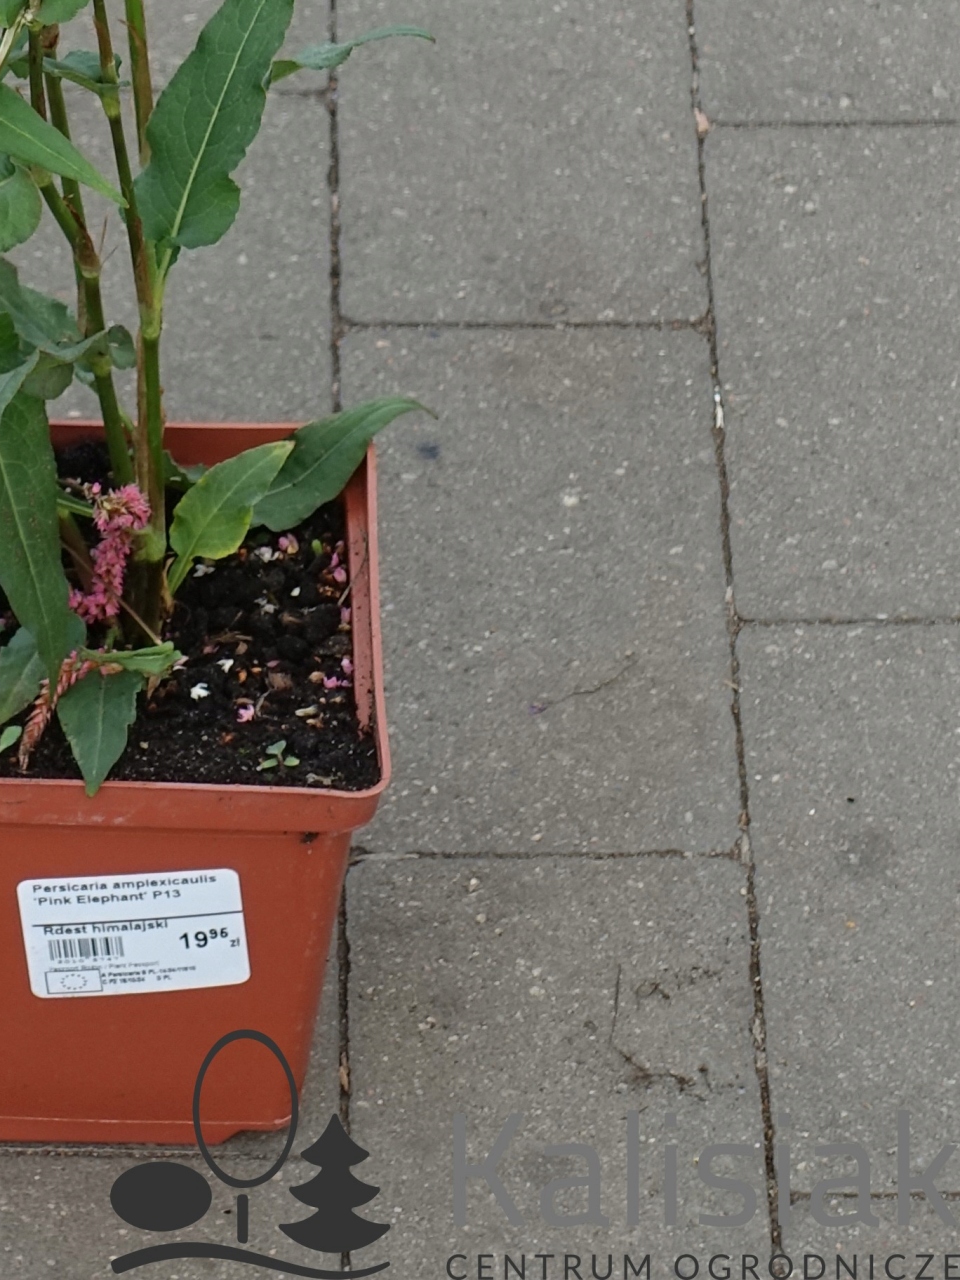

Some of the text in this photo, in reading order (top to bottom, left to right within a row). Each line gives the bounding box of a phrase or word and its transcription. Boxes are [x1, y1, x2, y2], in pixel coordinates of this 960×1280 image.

[32, 875, 217, 893] Persicaria amplexicaulis
[153, 889, 181, 899] P13
[43, 919, 168, 935] Rdest himalajski
